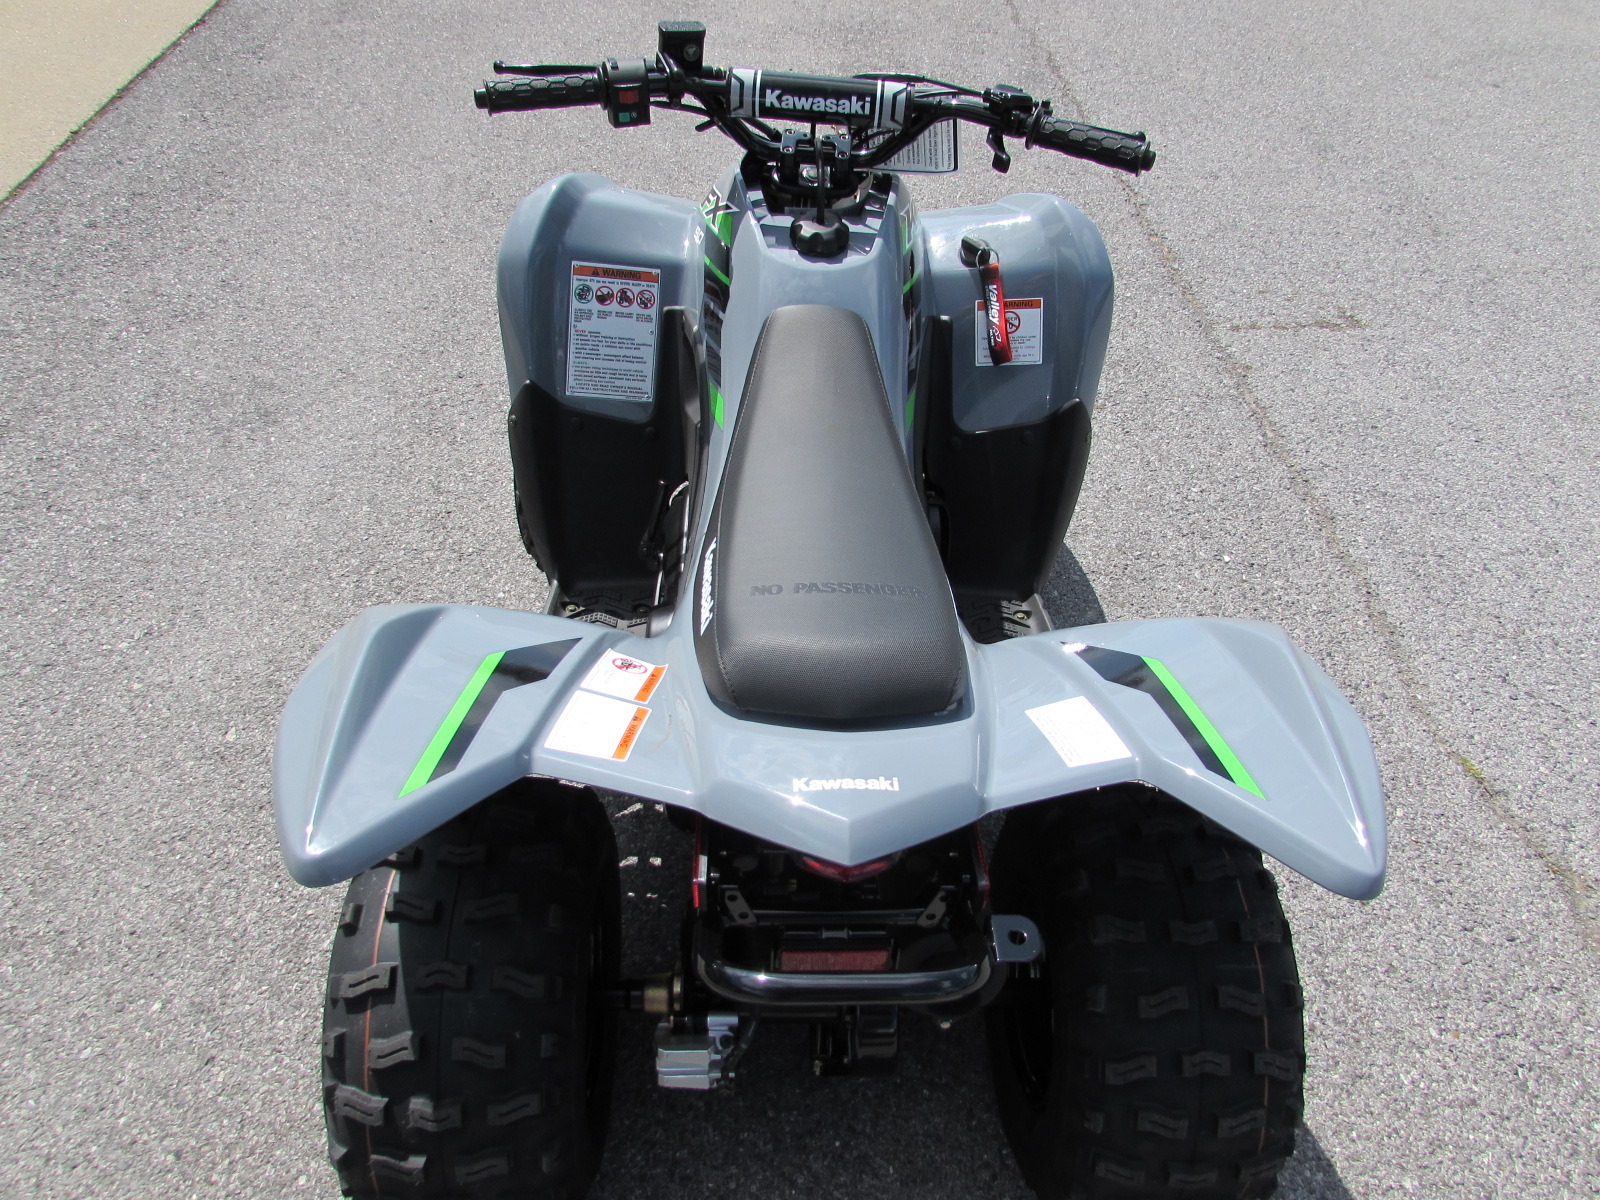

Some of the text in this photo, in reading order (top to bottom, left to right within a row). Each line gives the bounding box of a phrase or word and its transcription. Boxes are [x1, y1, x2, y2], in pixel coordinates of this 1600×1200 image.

[765, 89, 871, 115] Kawasaki
[602, 269, 641, 280] WARNING
[988, 284, 1000, 325] Valley
[750, 584, 784, 596] NO
[792, 776, 900, 793] Kawasaki
